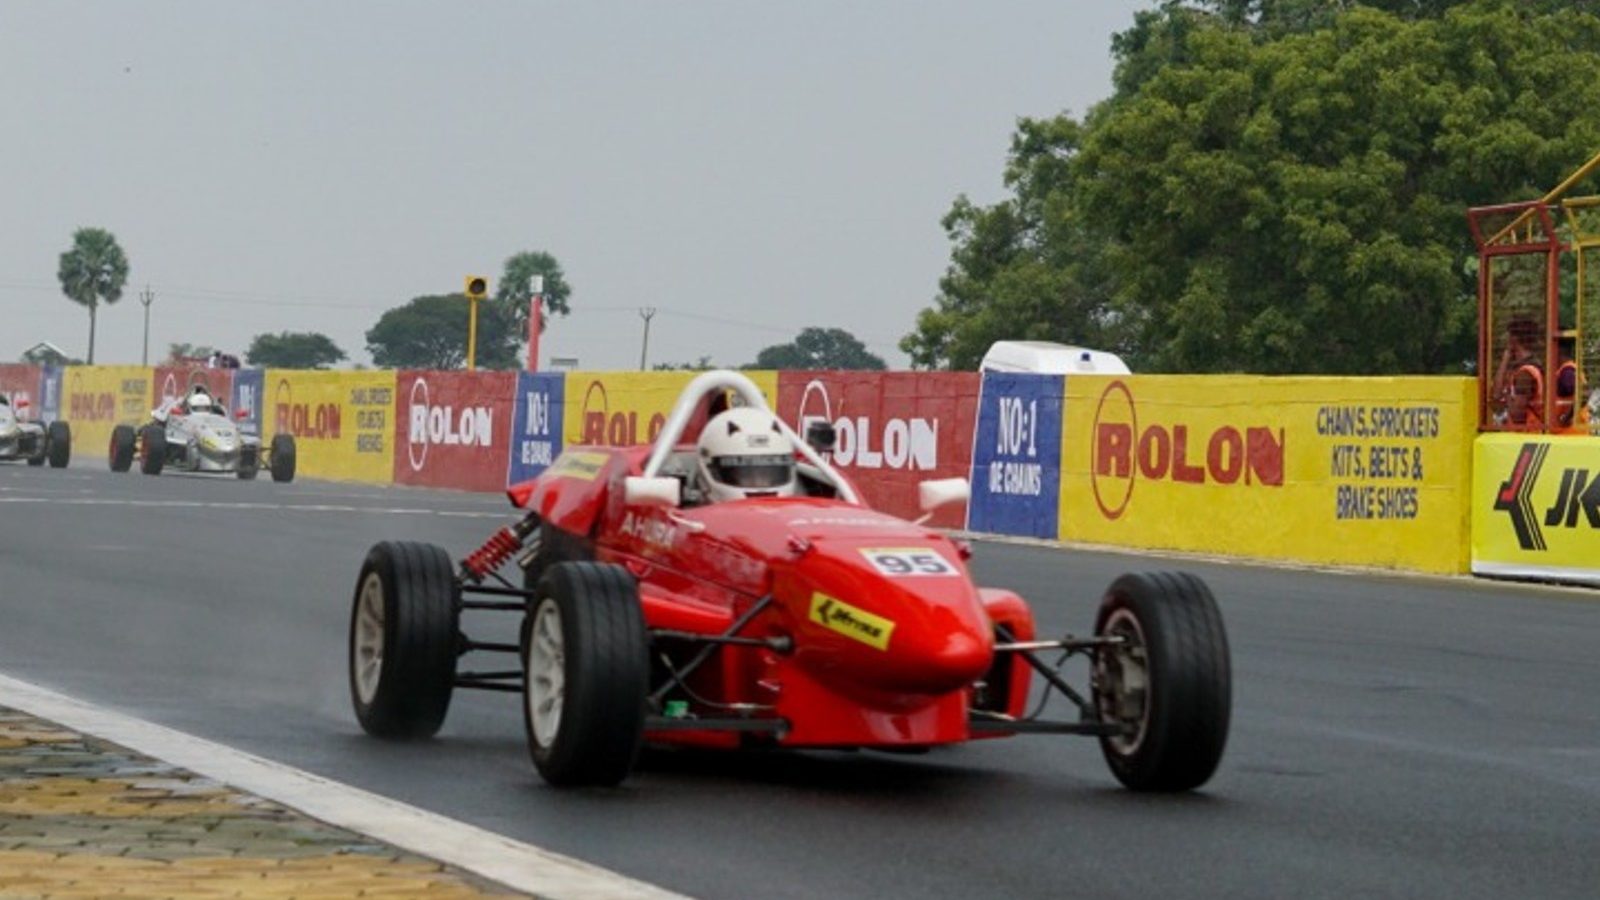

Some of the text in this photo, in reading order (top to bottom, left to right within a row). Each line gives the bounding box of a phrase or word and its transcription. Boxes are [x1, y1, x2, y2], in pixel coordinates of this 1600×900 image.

[276, 403, 341, 438] ROLON
[410, 404, 493, 446] ROLON
[1097, 423, 1285, 486] ROLON
[1369, 447, 1407, 479] BELTS
[1336, 486, 1418, 519] BRAKE SHOES
[876, 556, 948, 573] 95
